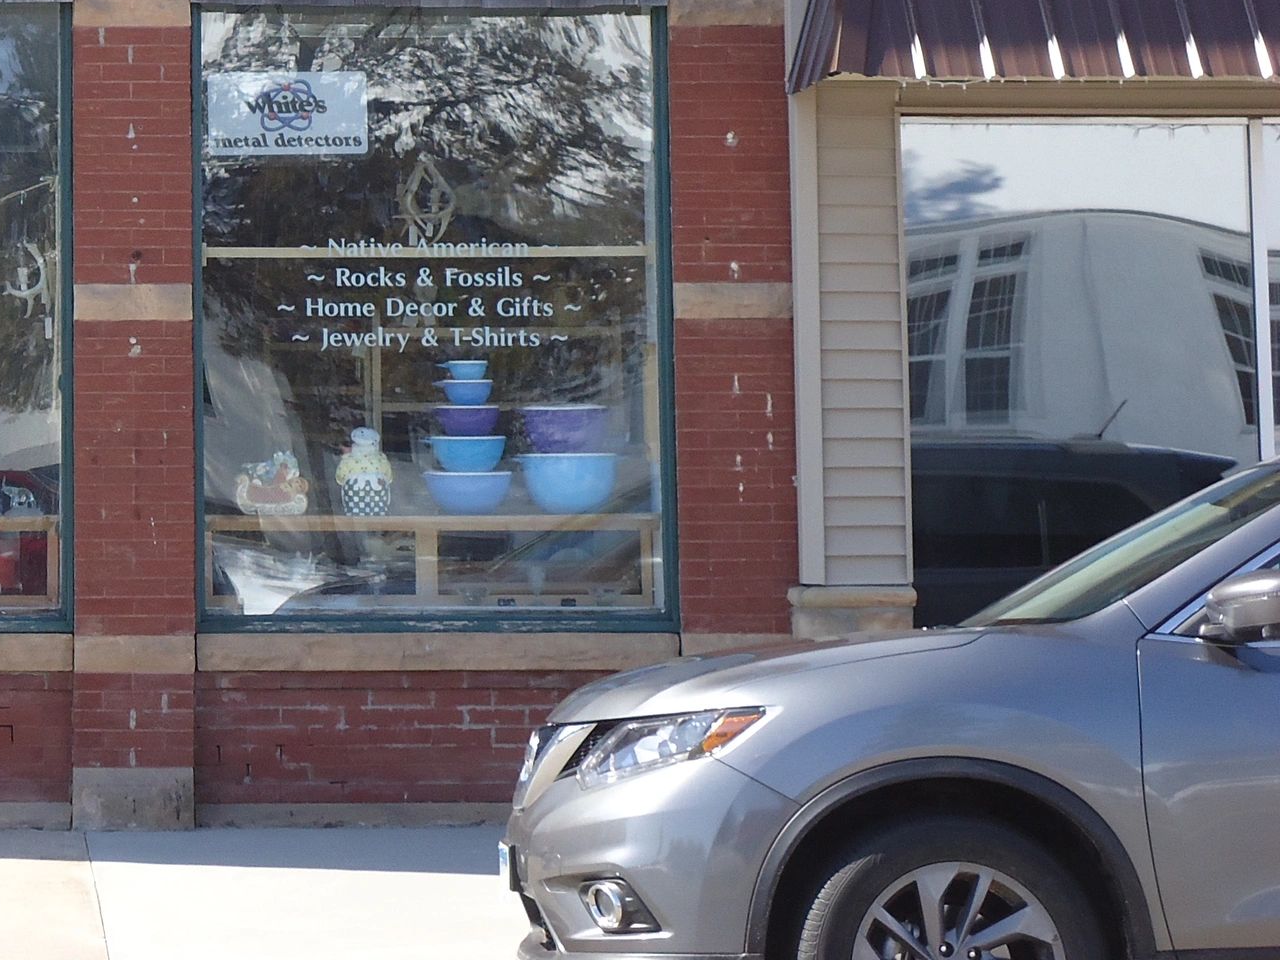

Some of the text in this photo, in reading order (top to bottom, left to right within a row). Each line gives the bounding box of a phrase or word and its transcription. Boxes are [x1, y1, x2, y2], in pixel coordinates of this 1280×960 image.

[215, 133, 363, 148] metal detectors
[327, 238, 529, 257] Native American
[335, 267, 523, 287] Rocks & Fossils
[305, 297, 554, 317] Home Decor & Gifts
[321, 327, 540, 352] Jewelry & T-Shirts
